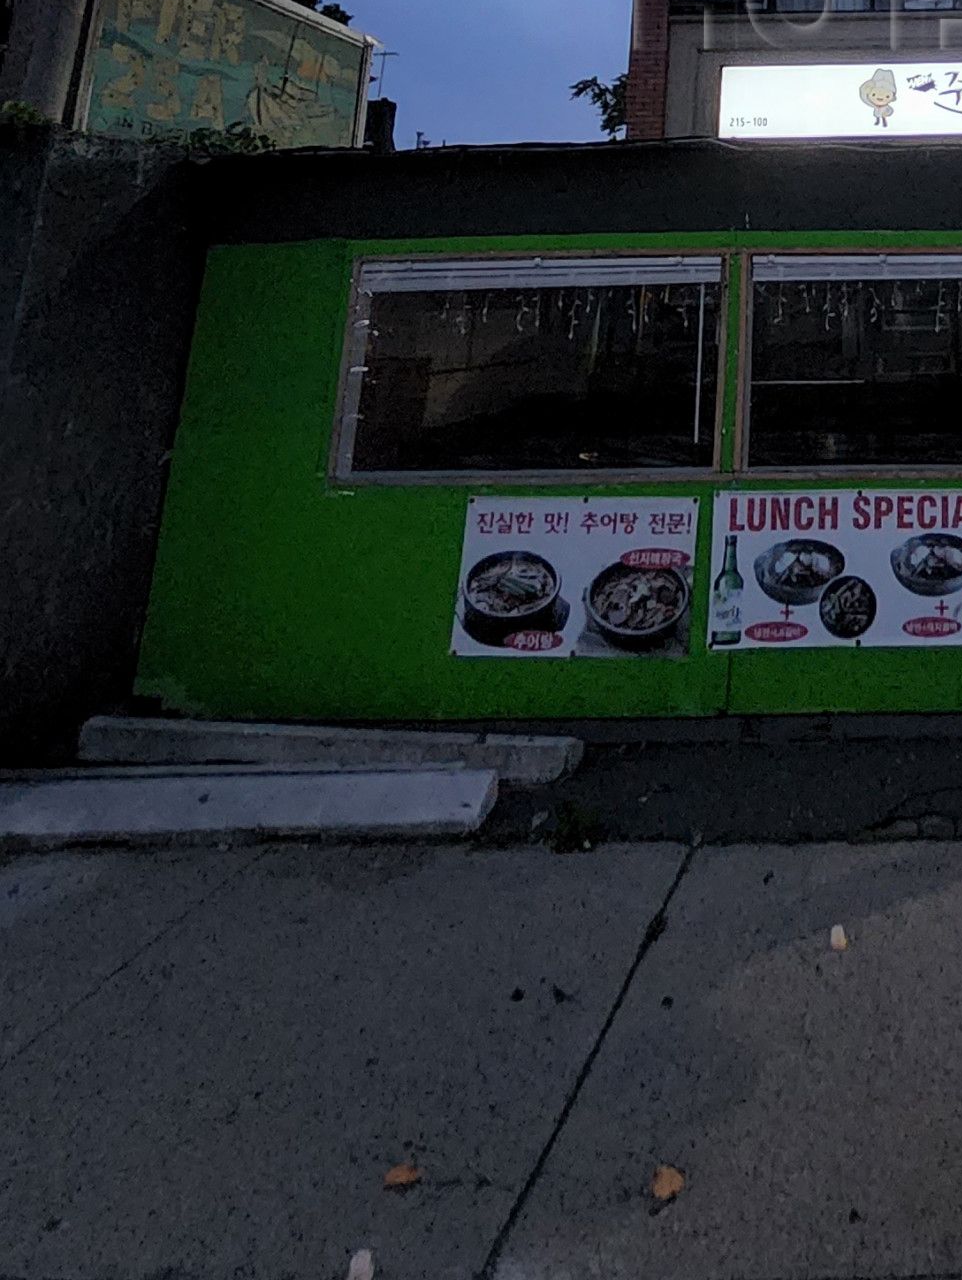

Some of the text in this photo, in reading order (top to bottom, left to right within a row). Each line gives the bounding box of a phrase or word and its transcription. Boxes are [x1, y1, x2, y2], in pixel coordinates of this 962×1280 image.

[477, 511, 692, 535] 진실한 맛! 추어탕 전문!
[729, 496, 839, 532] LUNCH
